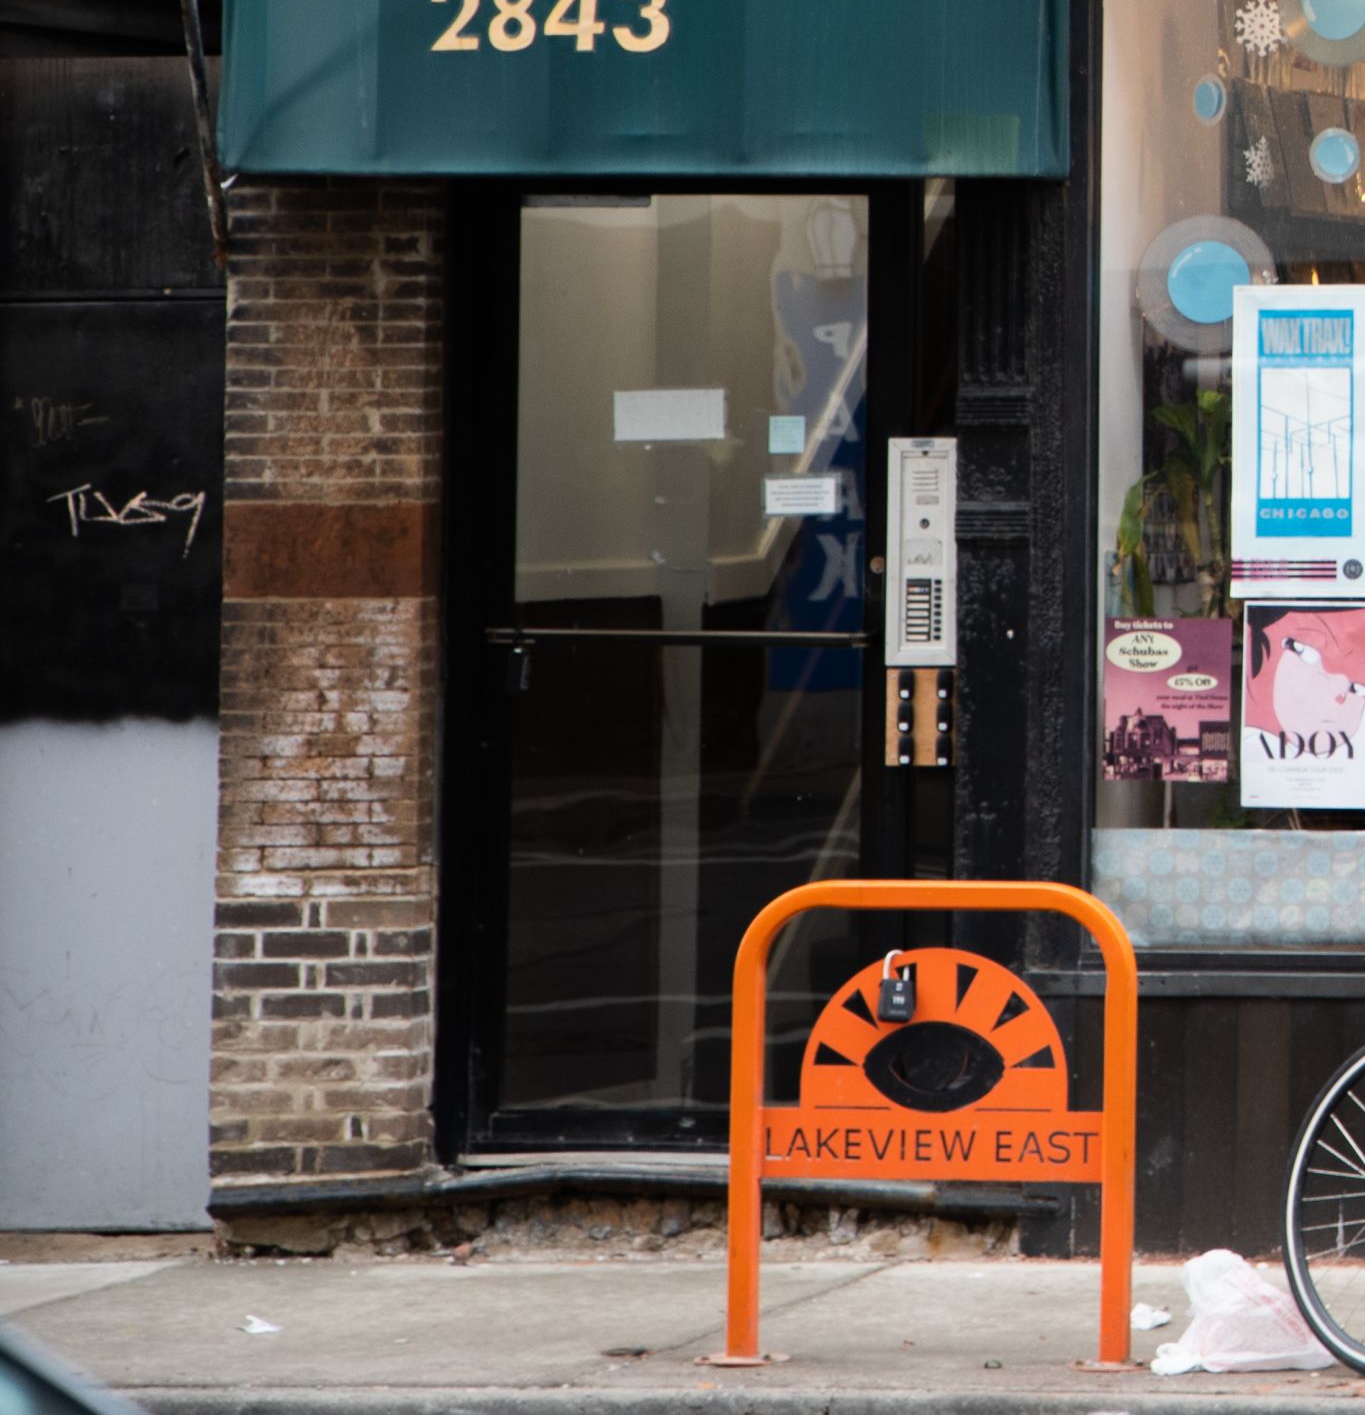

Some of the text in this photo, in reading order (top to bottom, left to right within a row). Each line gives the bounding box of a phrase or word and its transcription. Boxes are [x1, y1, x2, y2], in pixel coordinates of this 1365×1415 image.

[1260, 508, 1349, 519] CHICAGO
[1132, 621, 1162, 629] tickets
[1119, 647, 1168, 656] Schubas
[1129, 659, 1158, 668] Show
[1259, 731, 1354, 759] ADOY
[765, 1127, 1098, 1164] LAKEVIEW EAST
